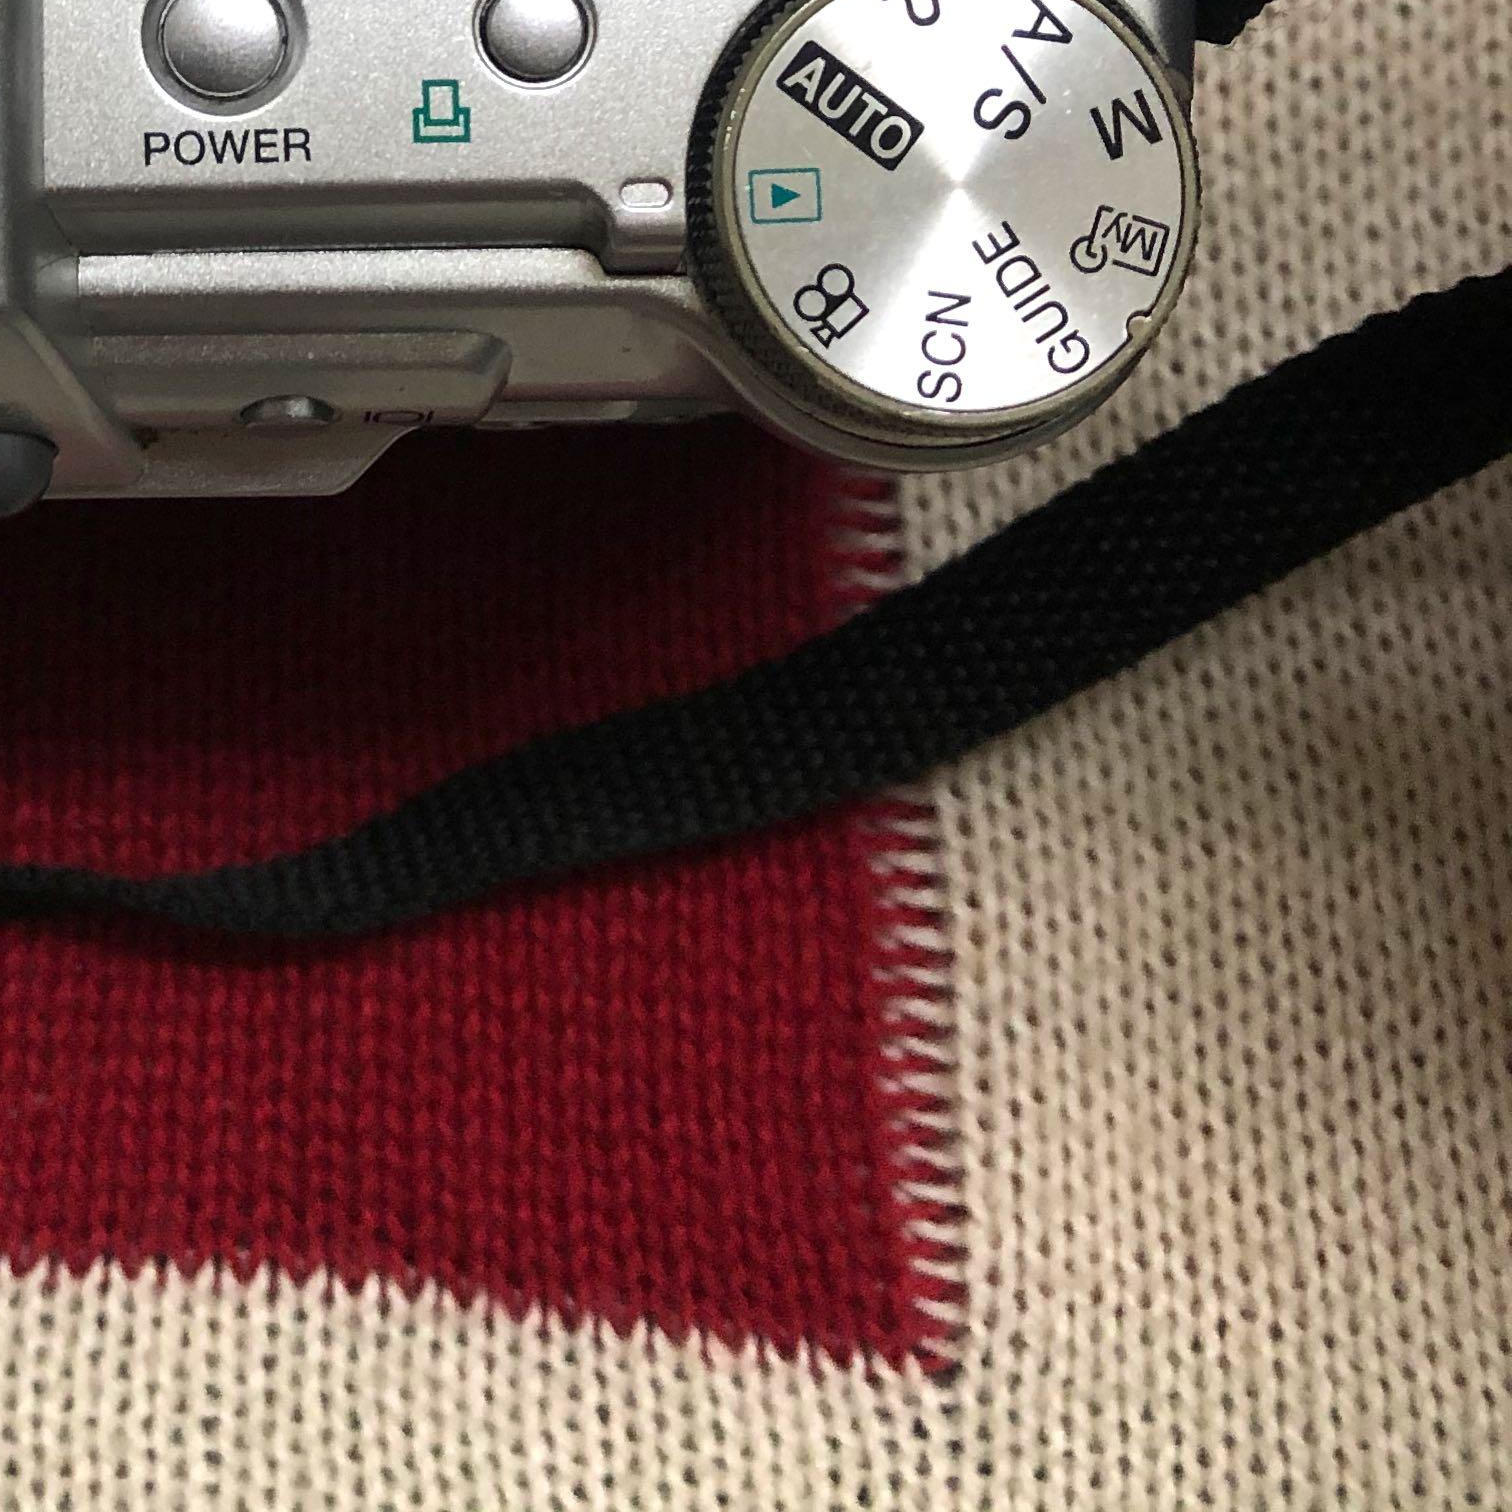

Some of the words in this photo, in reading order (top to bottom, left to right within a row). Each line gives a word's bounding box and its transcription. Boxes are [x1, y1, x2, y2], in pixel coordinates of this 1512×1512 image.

[143, 127, 312, 167] POWER
[783, 54, 913, 162] AUTO
[1090, 89, 1164, 161] M
[917, 290, 972, 404] SCN
[972, 221, 1090, 375] GUIDE
